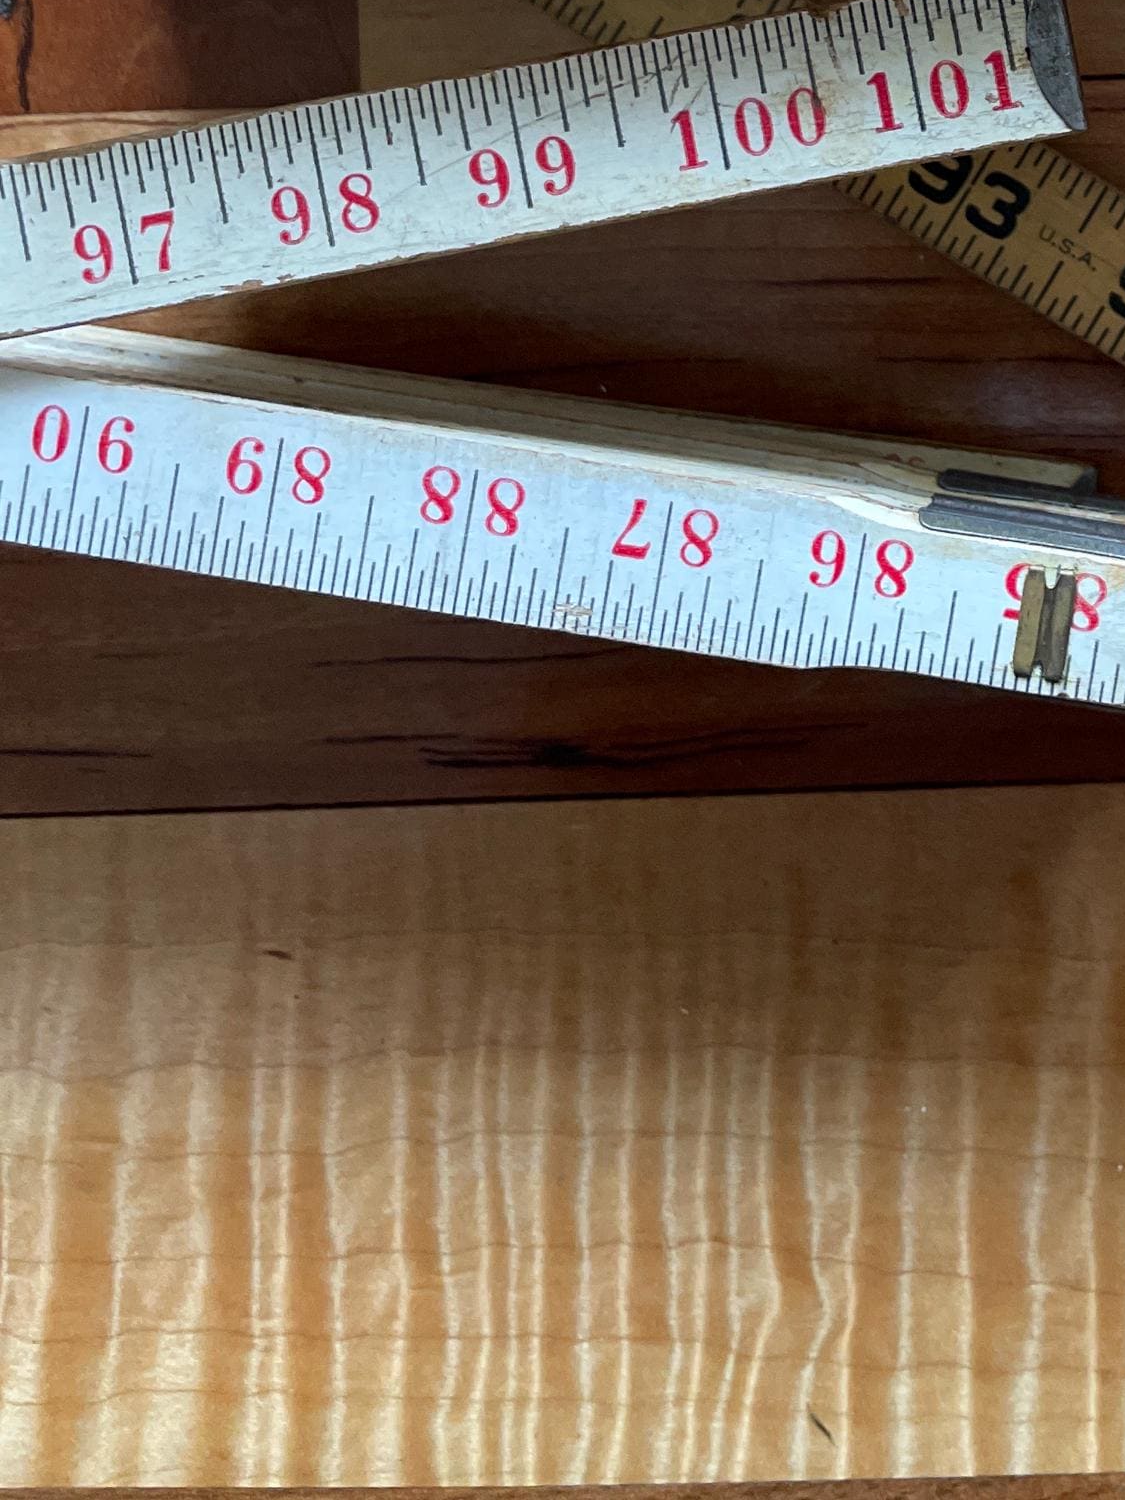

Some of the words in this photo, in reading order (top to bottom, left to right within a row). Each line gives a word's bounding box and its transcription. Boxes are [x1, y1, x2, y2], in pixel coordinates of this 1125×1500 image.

[72, 211, 175, 284] 97
[270, 173, 381, 245] 98
[468, 135, 577, 208] 99
[671, 87, 827, 171] 100
[867, 50, 1021, 133] 101
[1039, 224, 1097, 273] U.S.A.
[31, 405, 135, 475] 90
[226, 437, 332, 505] 89
[420, 466, 526, 538] 88
[612, 498, 720, 568] 87
[808, 530, 916, 599] 86
